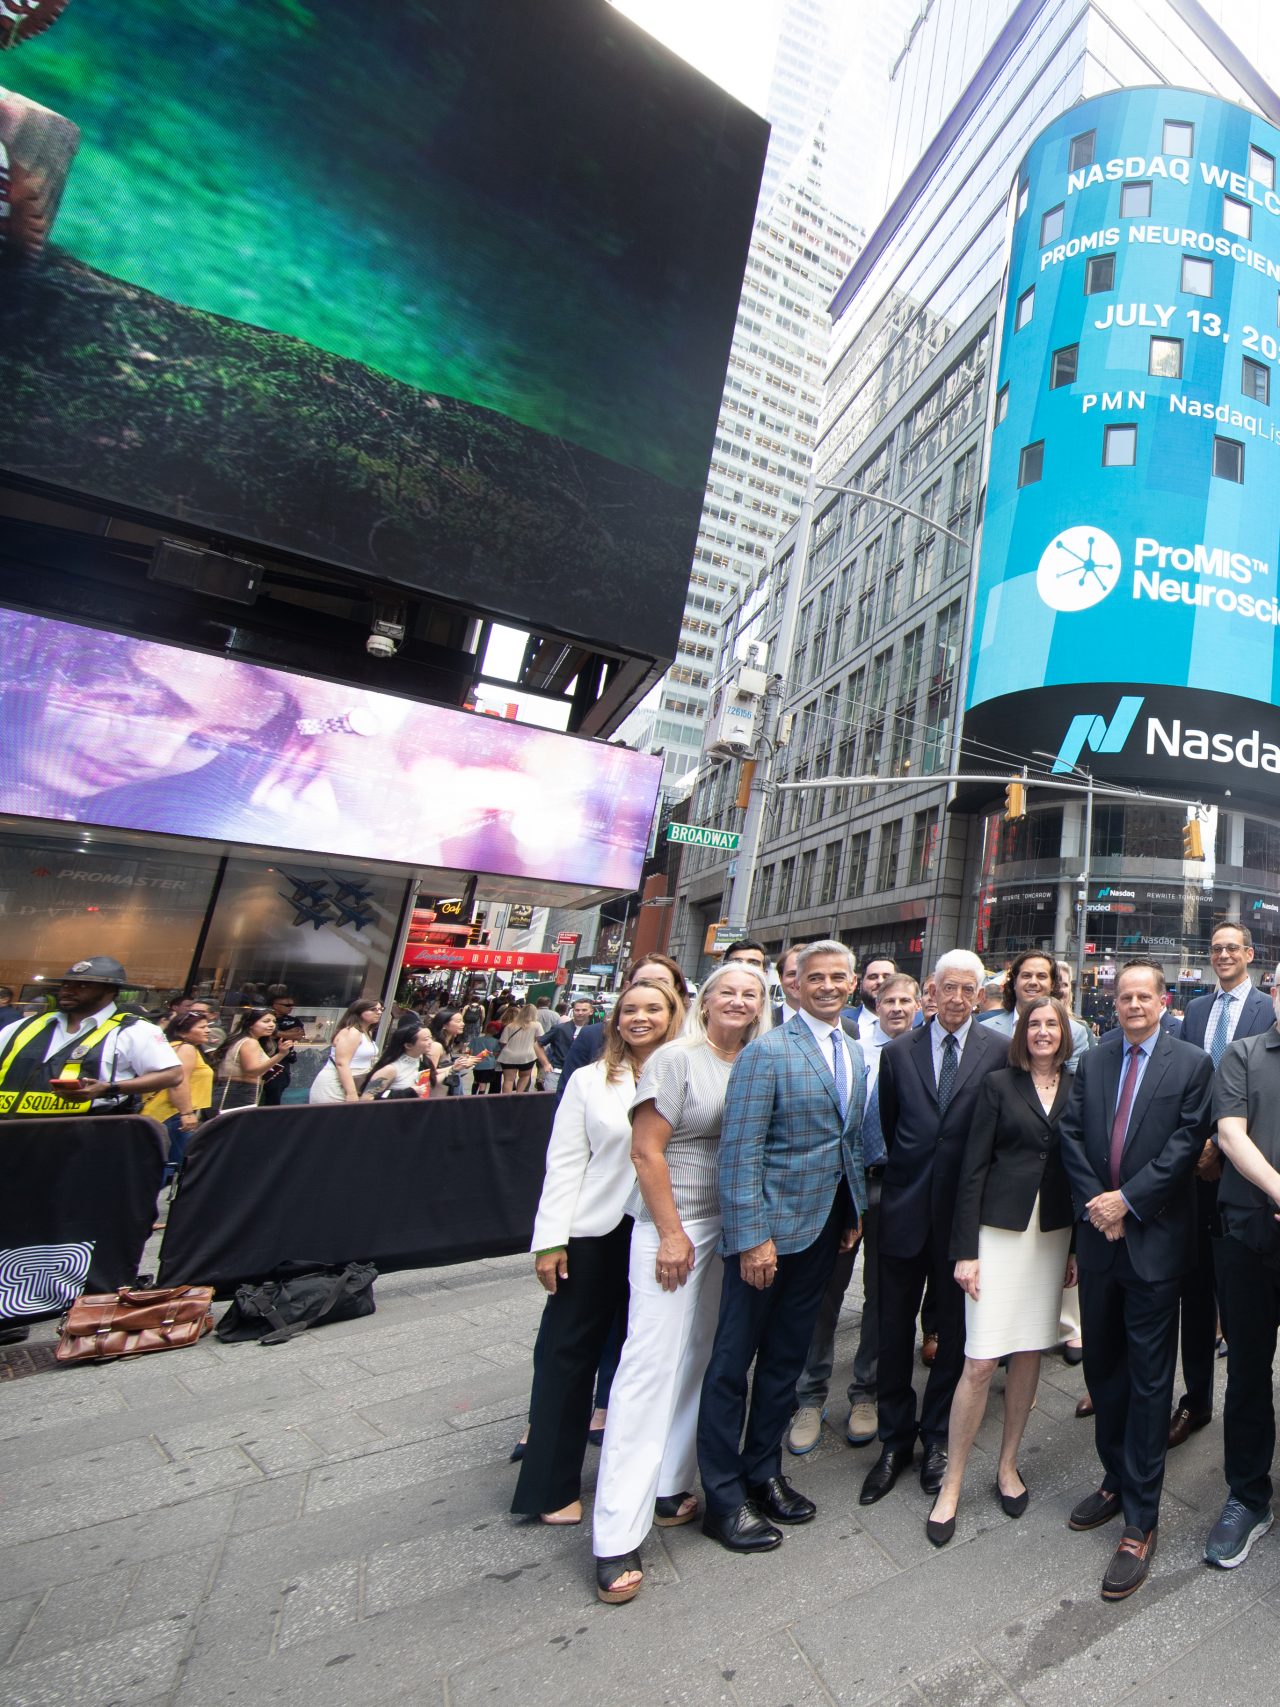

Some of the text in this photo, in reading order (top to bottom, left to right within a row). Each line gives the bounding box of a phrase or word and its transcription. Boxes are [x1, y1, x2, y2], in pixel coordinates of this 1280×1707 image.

[1066, 156, 1190, 195] NASDAQ
[1040, 227, 1120, 271] PROMIS
[1094, 303, 1177, 330] JULY
[1186, 309, 1230, 344] 13,
[671, 826, 736, 848] BROADWAY
[57, 869, 188, 890] PROMASTER
[1110, 889, 1135, 898] Nasdaq
[1146, 892, 1176, 900] REWRITE
[1141, 936, 1176, 946] Nasdaq
[471, 953, 525, 965] DINER
[22, 1094, 81, 1111] SQUARE
